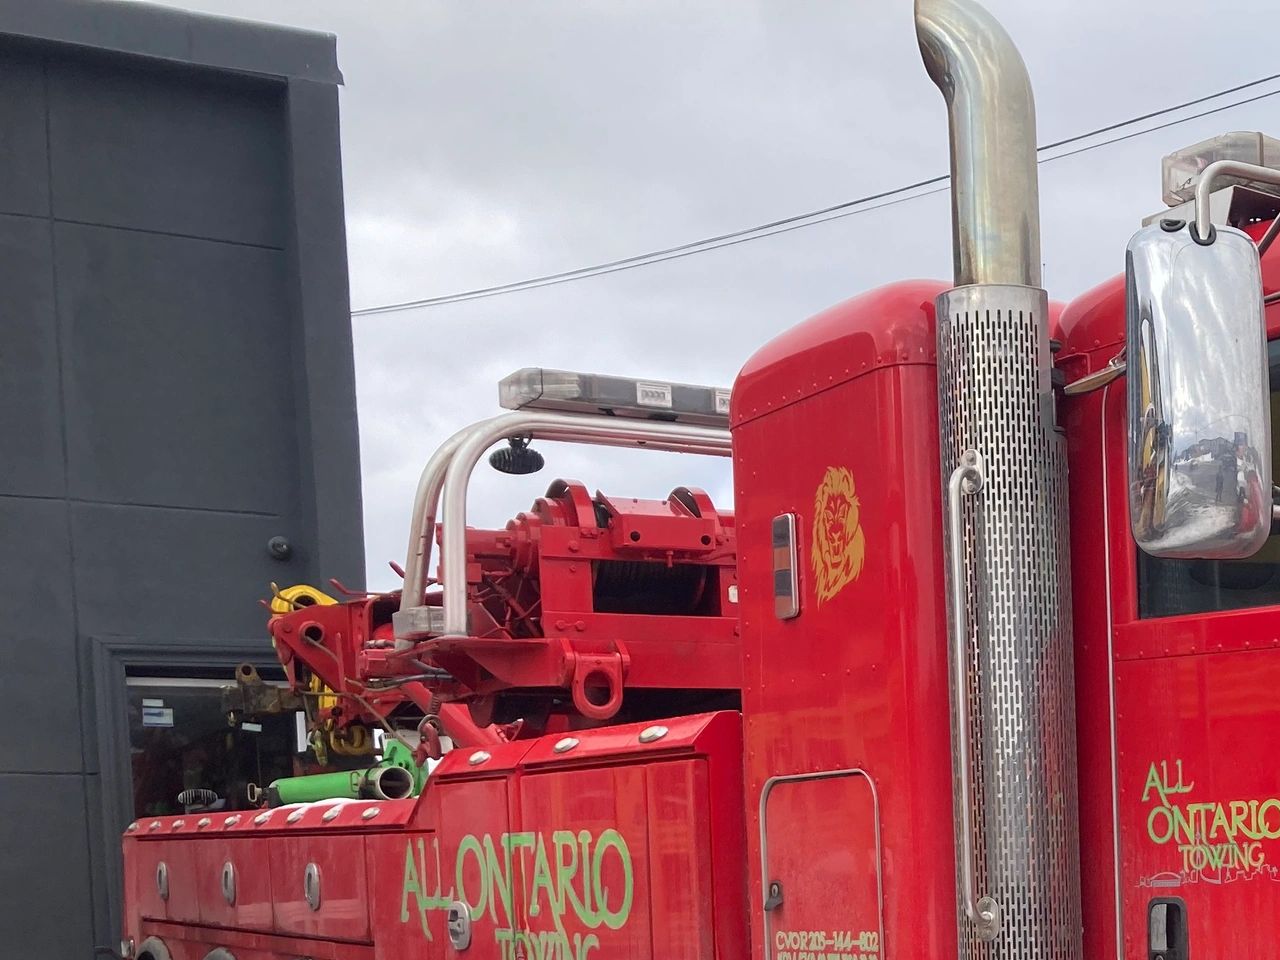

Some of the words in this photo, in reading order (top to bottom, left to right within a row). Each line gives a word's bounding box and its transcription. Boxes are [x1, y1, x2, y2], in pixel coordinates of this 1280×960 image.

[1141, 759, 1194, 809] ALL
[1178, 840, 1265, 873] TOWING
[400, 836, 454, 942] ALL
[455, 828, 634, 934] ONTARIO
[775, 930, 808, 951] CVOR
